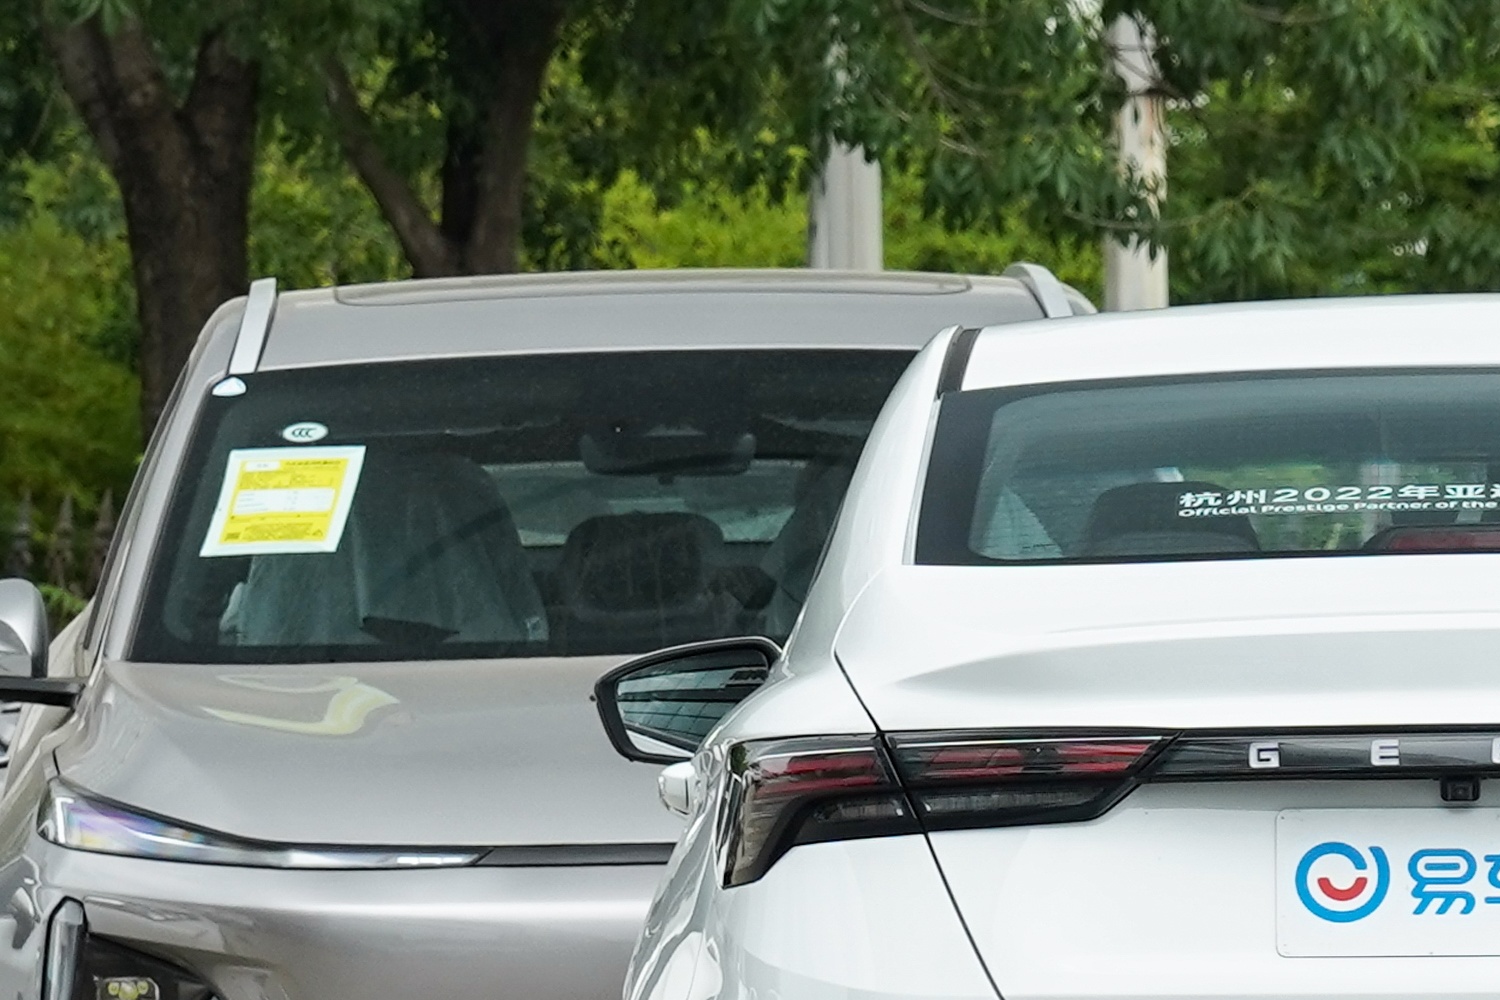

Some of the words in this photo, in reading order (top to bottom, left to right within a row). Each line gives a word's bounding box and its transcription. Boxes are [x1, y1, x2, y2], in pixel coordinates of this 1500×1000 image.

[1178, 506, 1258, 517] Official
[1261, 503, 1349, 514] Prestige
[1353, 500, 1433, 510] Partner
[1435, 500, 1458, 509] of
[1462, 500, 1498, 509] the
